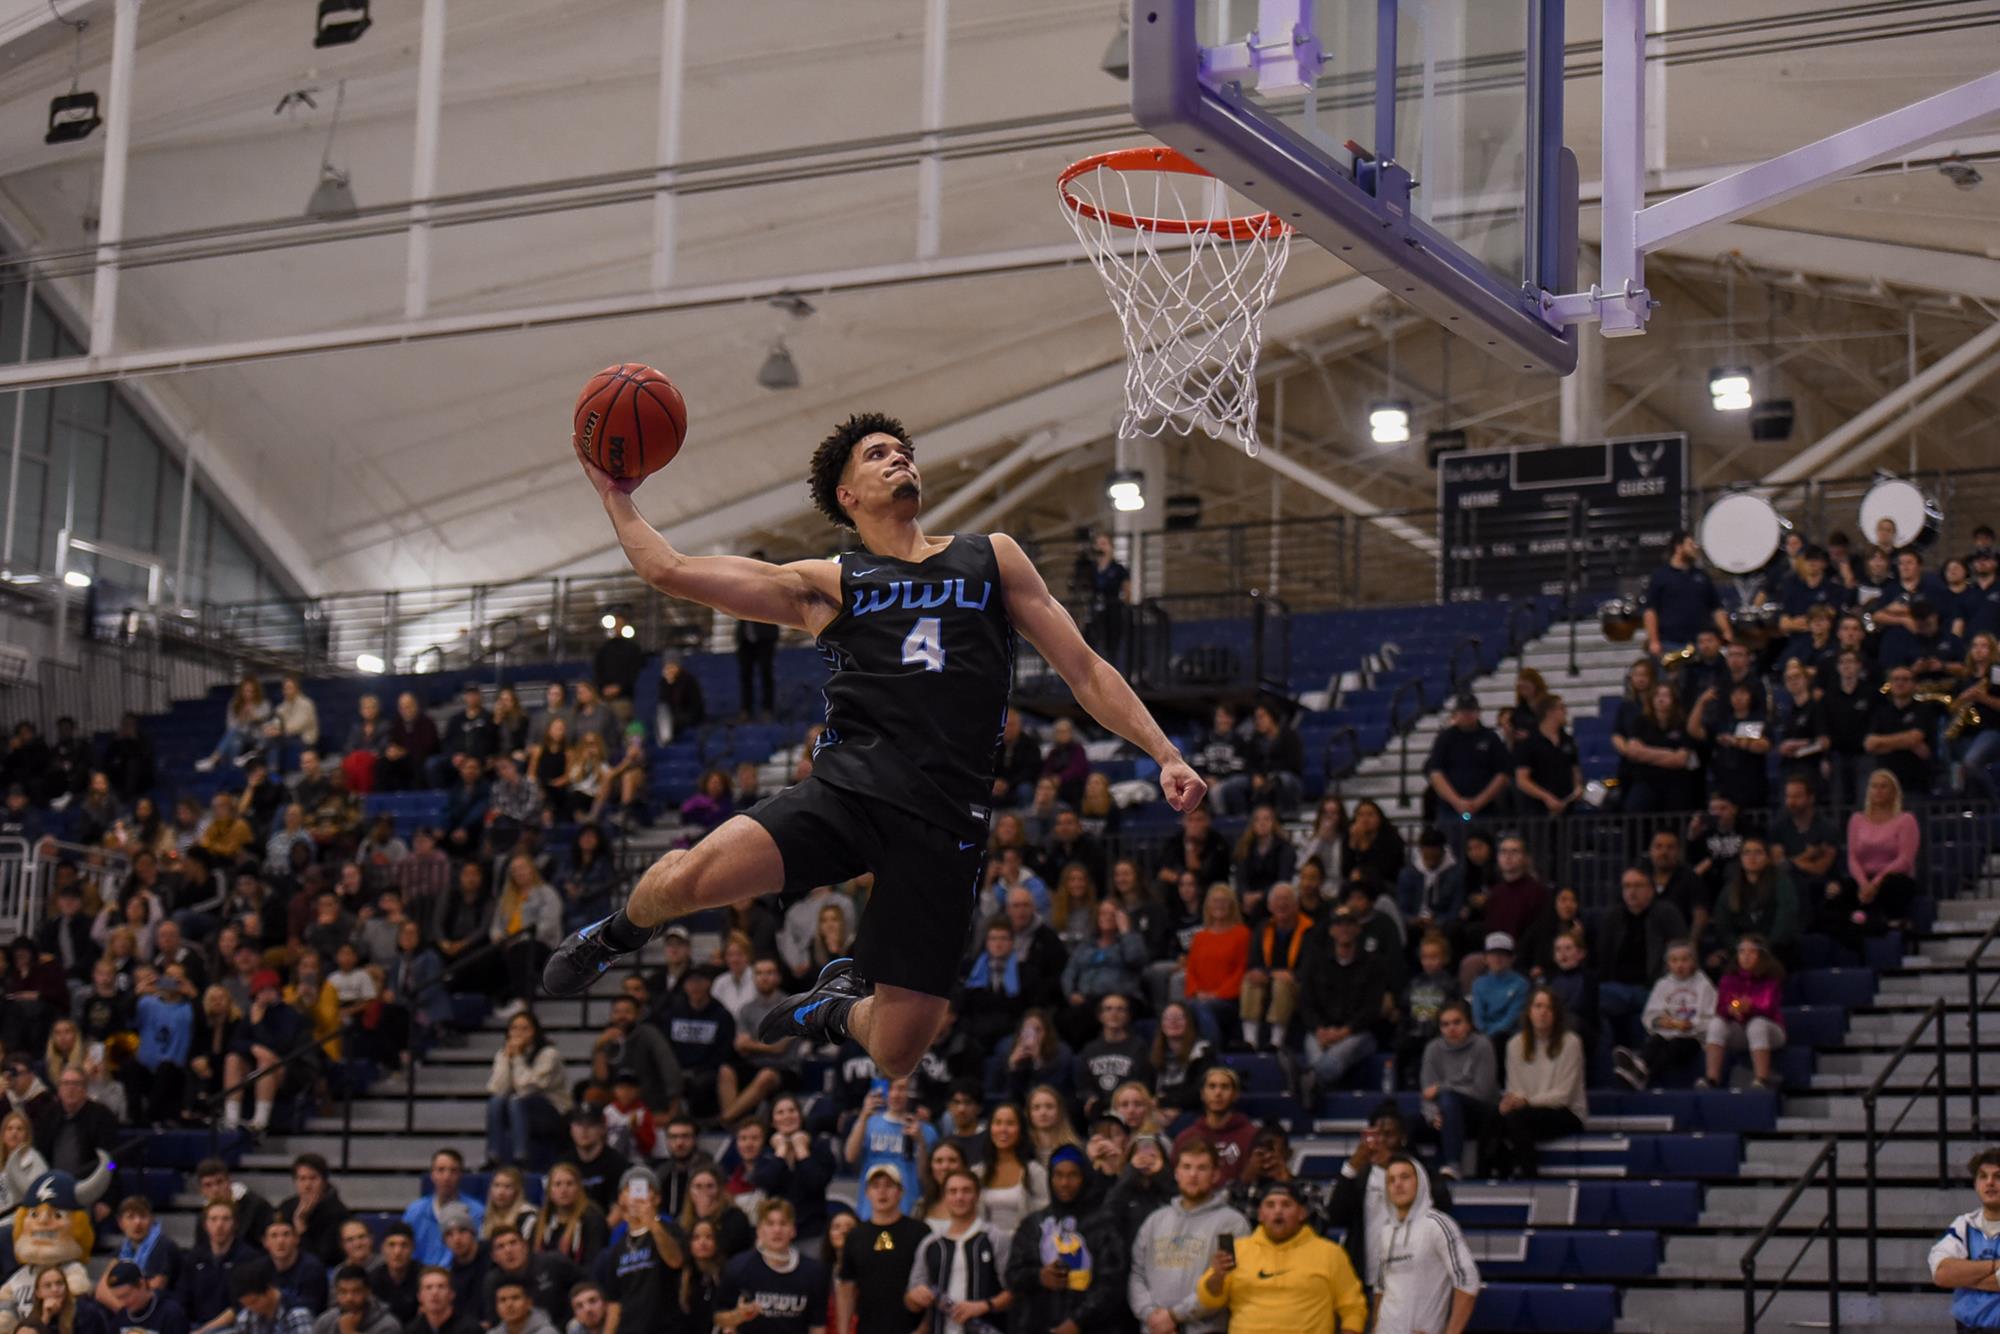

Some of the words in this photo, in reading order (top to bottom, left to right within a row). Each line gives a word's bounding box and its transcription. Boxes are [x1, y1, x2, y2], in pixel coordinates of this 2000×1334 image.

[1616, 477, 1667, 497] GUEST
[852, 578, 992, 617] WWU
[901, 617, 946, 673] 4
[755, 1292, 808, 1312] WWU
